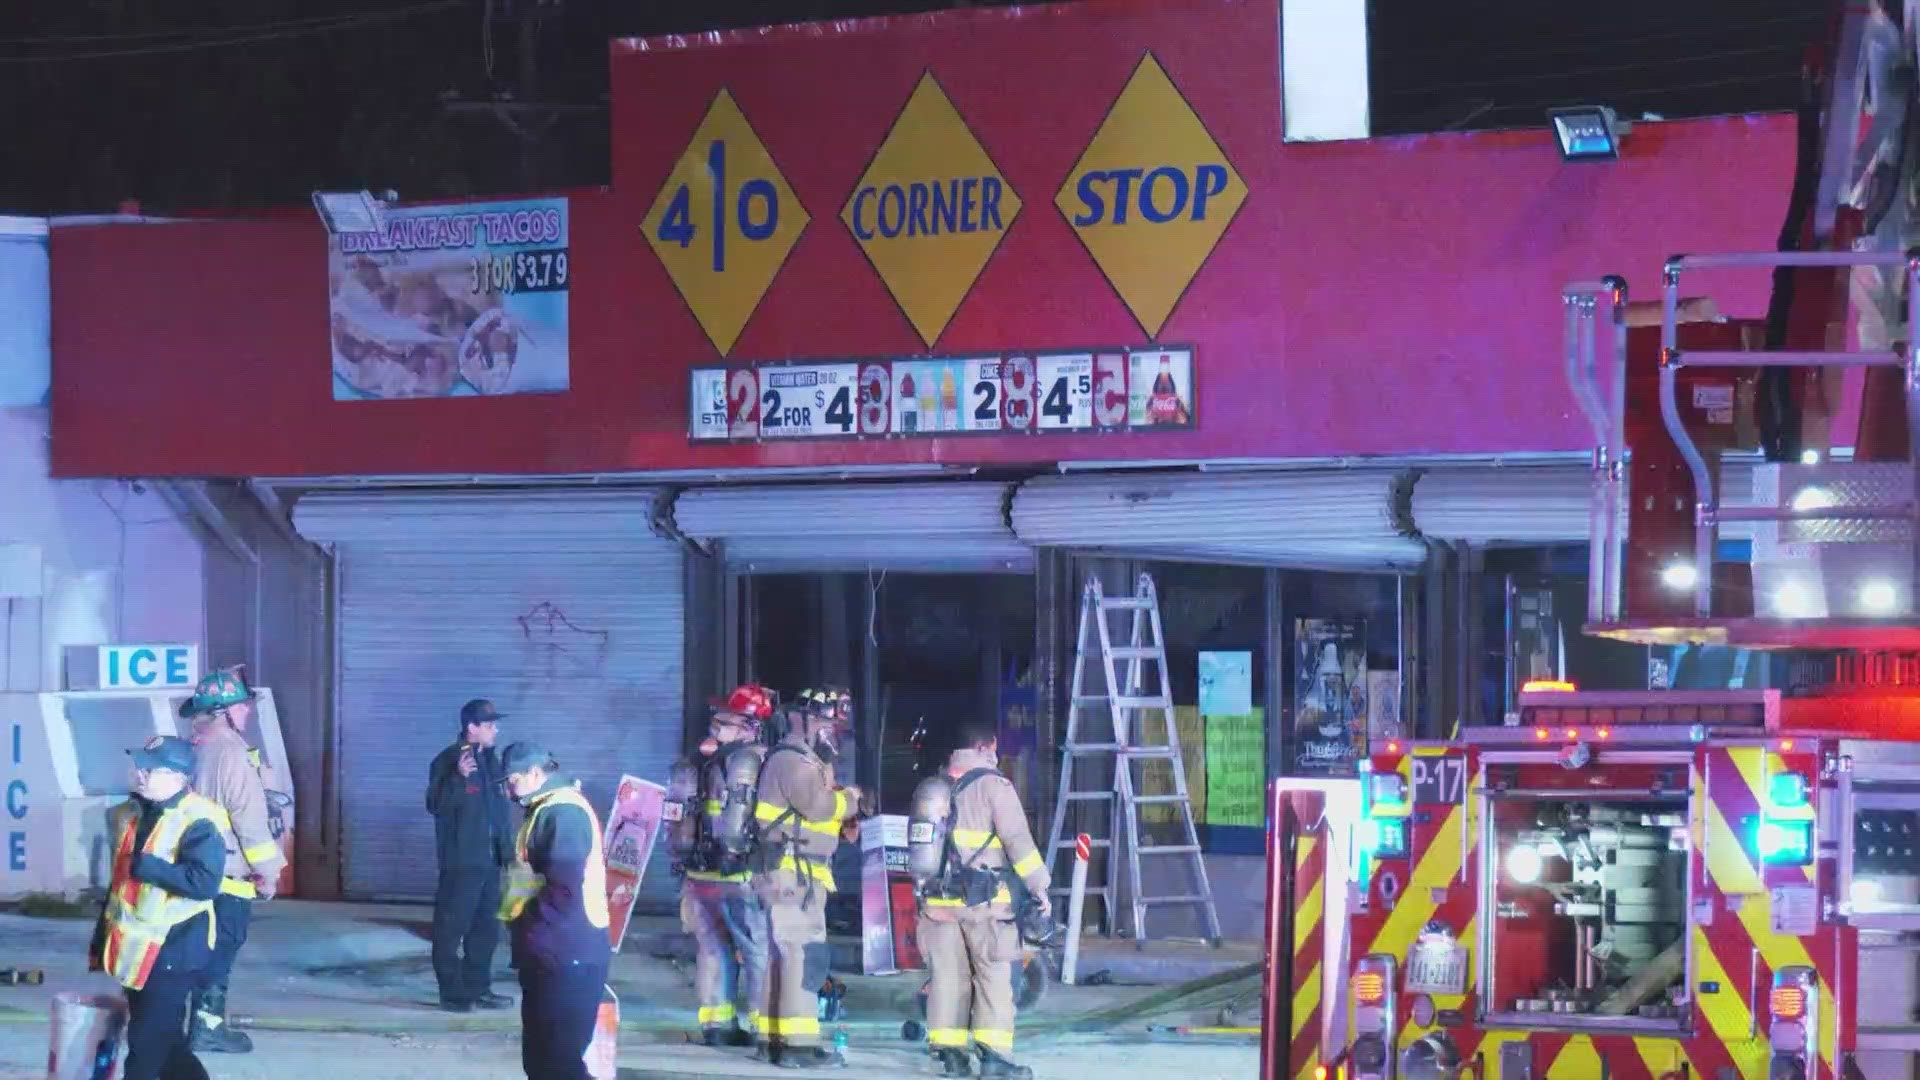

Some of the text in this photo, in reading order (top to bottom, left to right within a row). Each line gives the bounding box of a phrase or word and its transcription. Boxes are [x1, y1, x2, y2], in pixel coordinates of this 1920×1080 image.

[853, 177, 1003, 240] CORNER
[1074, 165, 1228, 227] STOP
[482, 209, 560, 244] TACOS
[484, 254, 514, 293] FOR
[517, 252, 567, 288] $3.79
[762, 389, 782, 427] 2
[784, 407, 811, 427] FOR
[974, 381, 997, 420] 2
[109, 649, 188, 685] ICE
[6, 724, 28, 871] ICE
[1411, 759, 1462, 801] P-17
